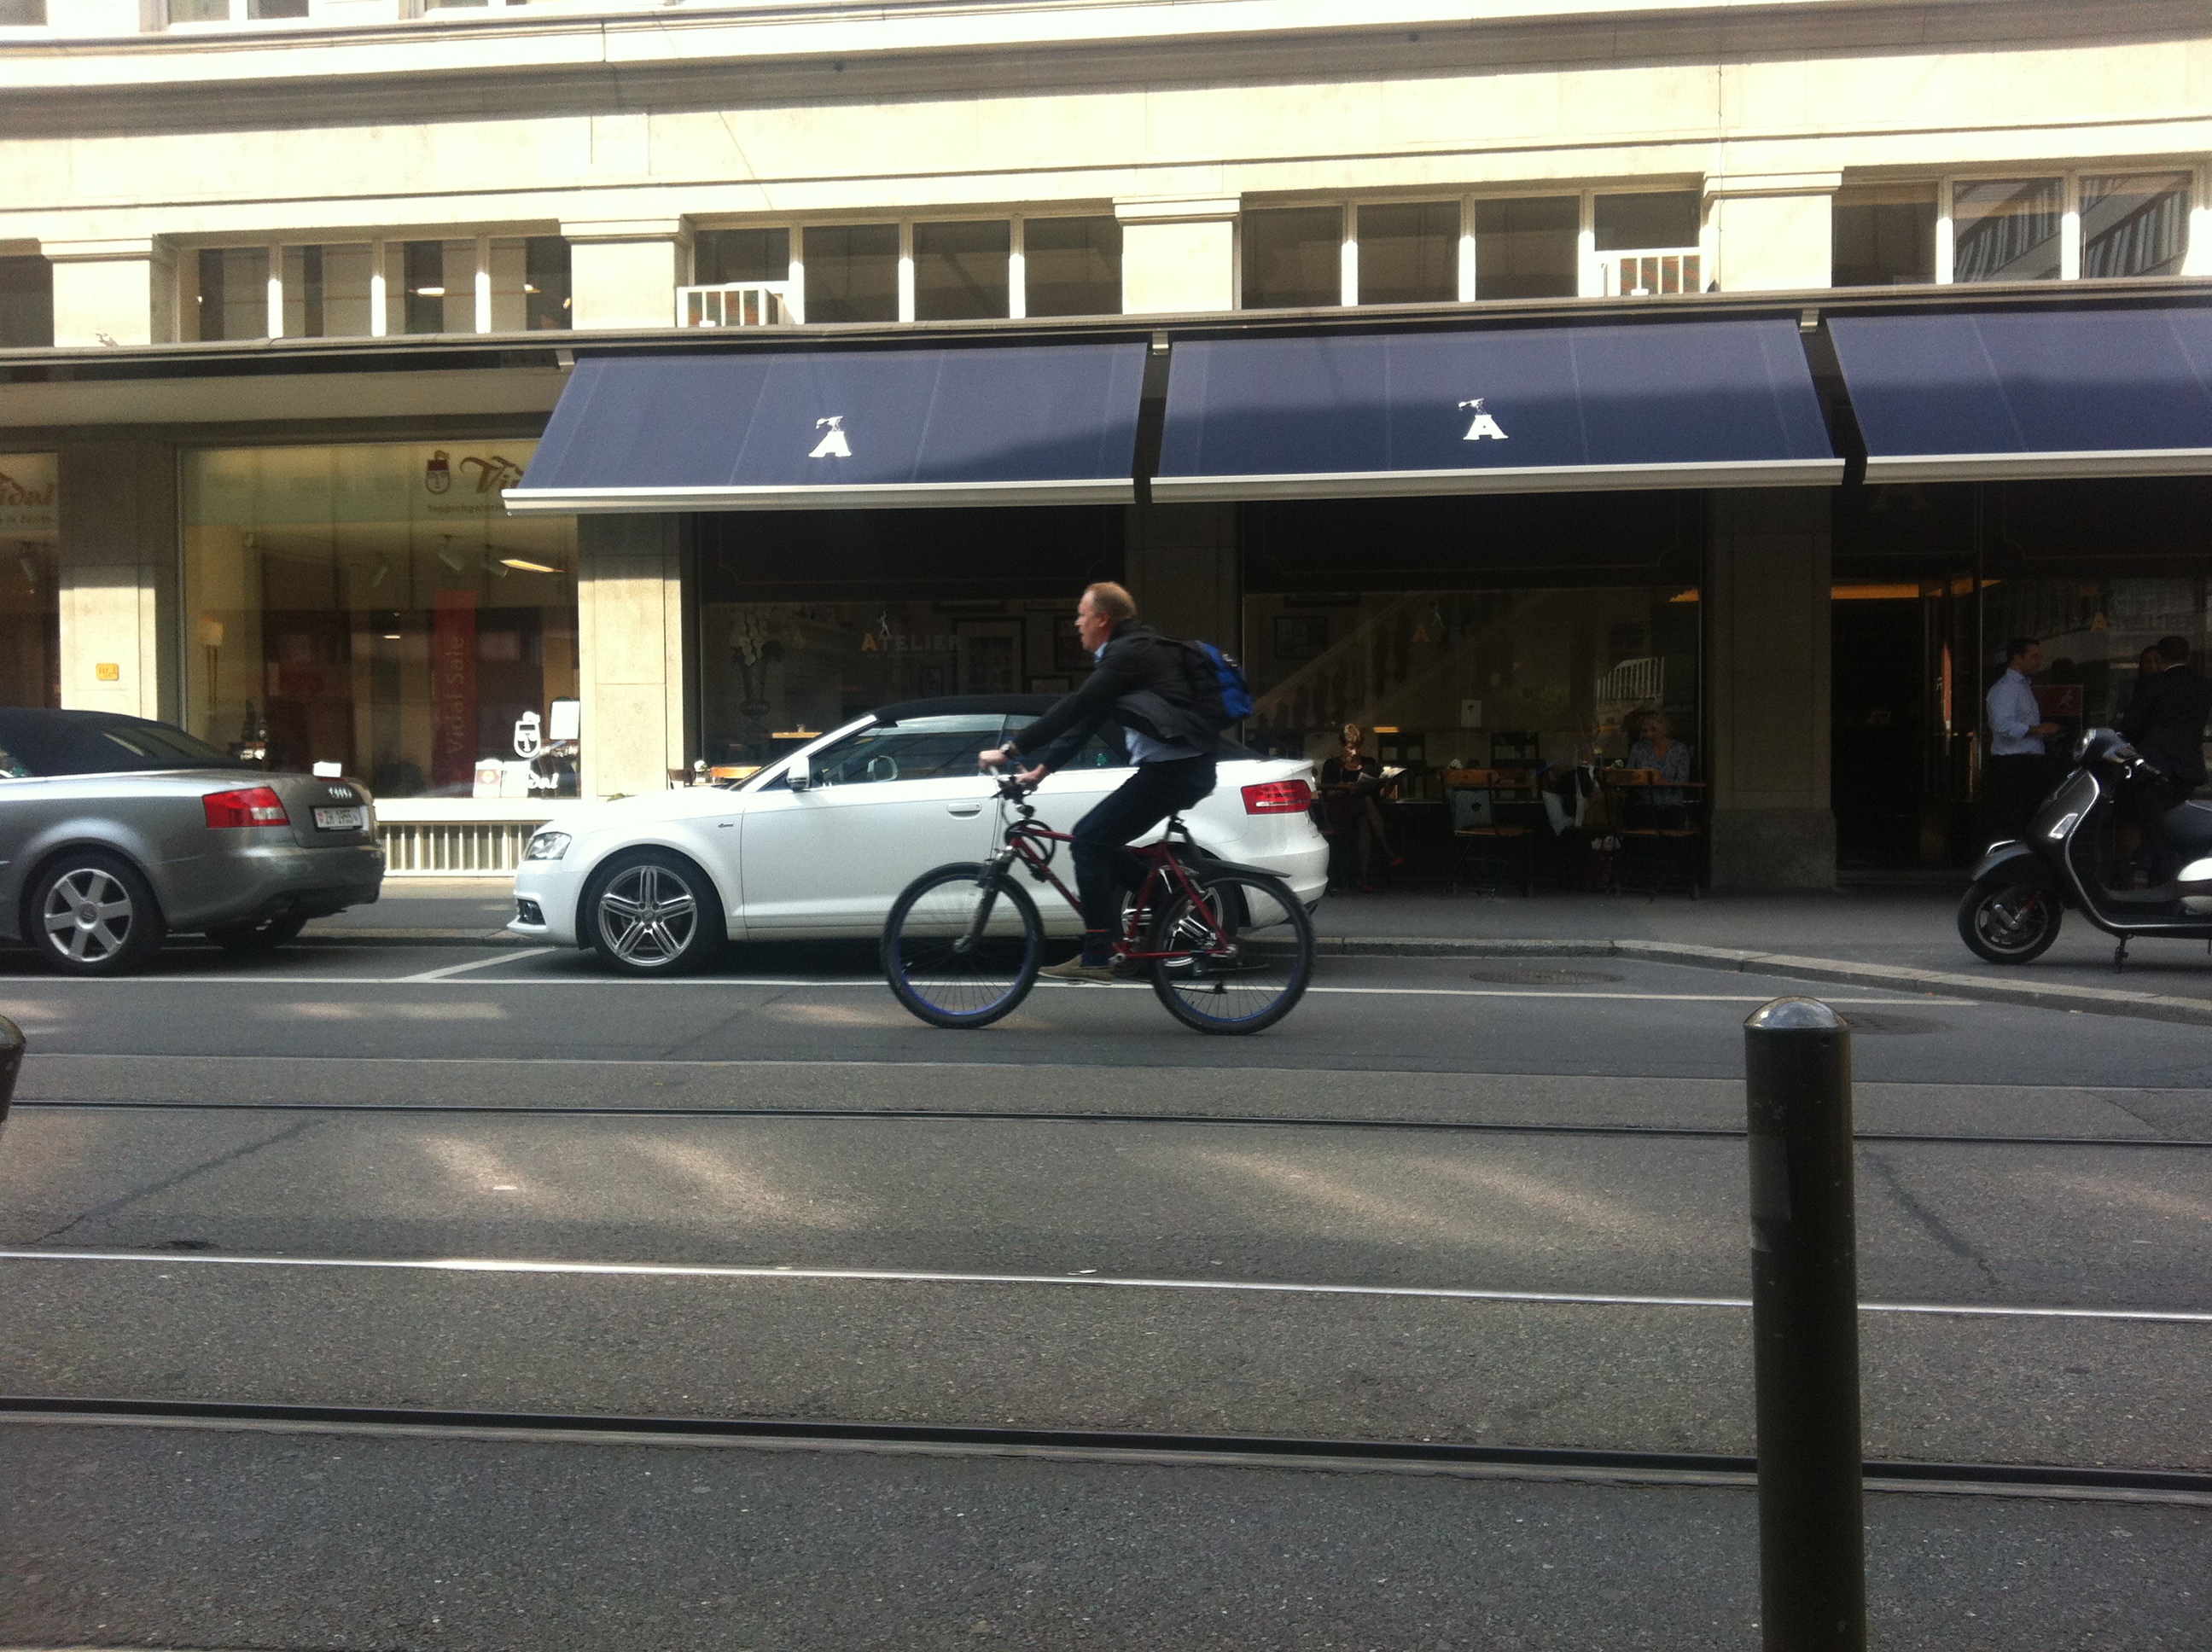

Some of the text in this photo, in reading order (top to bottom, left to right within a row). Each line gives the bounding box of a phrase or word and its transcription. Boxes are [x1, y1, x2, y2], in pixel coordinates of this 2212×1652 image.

[859, 631, 962, 652] ATELIER
[445, 636, 465, 754] Vidal Sale
